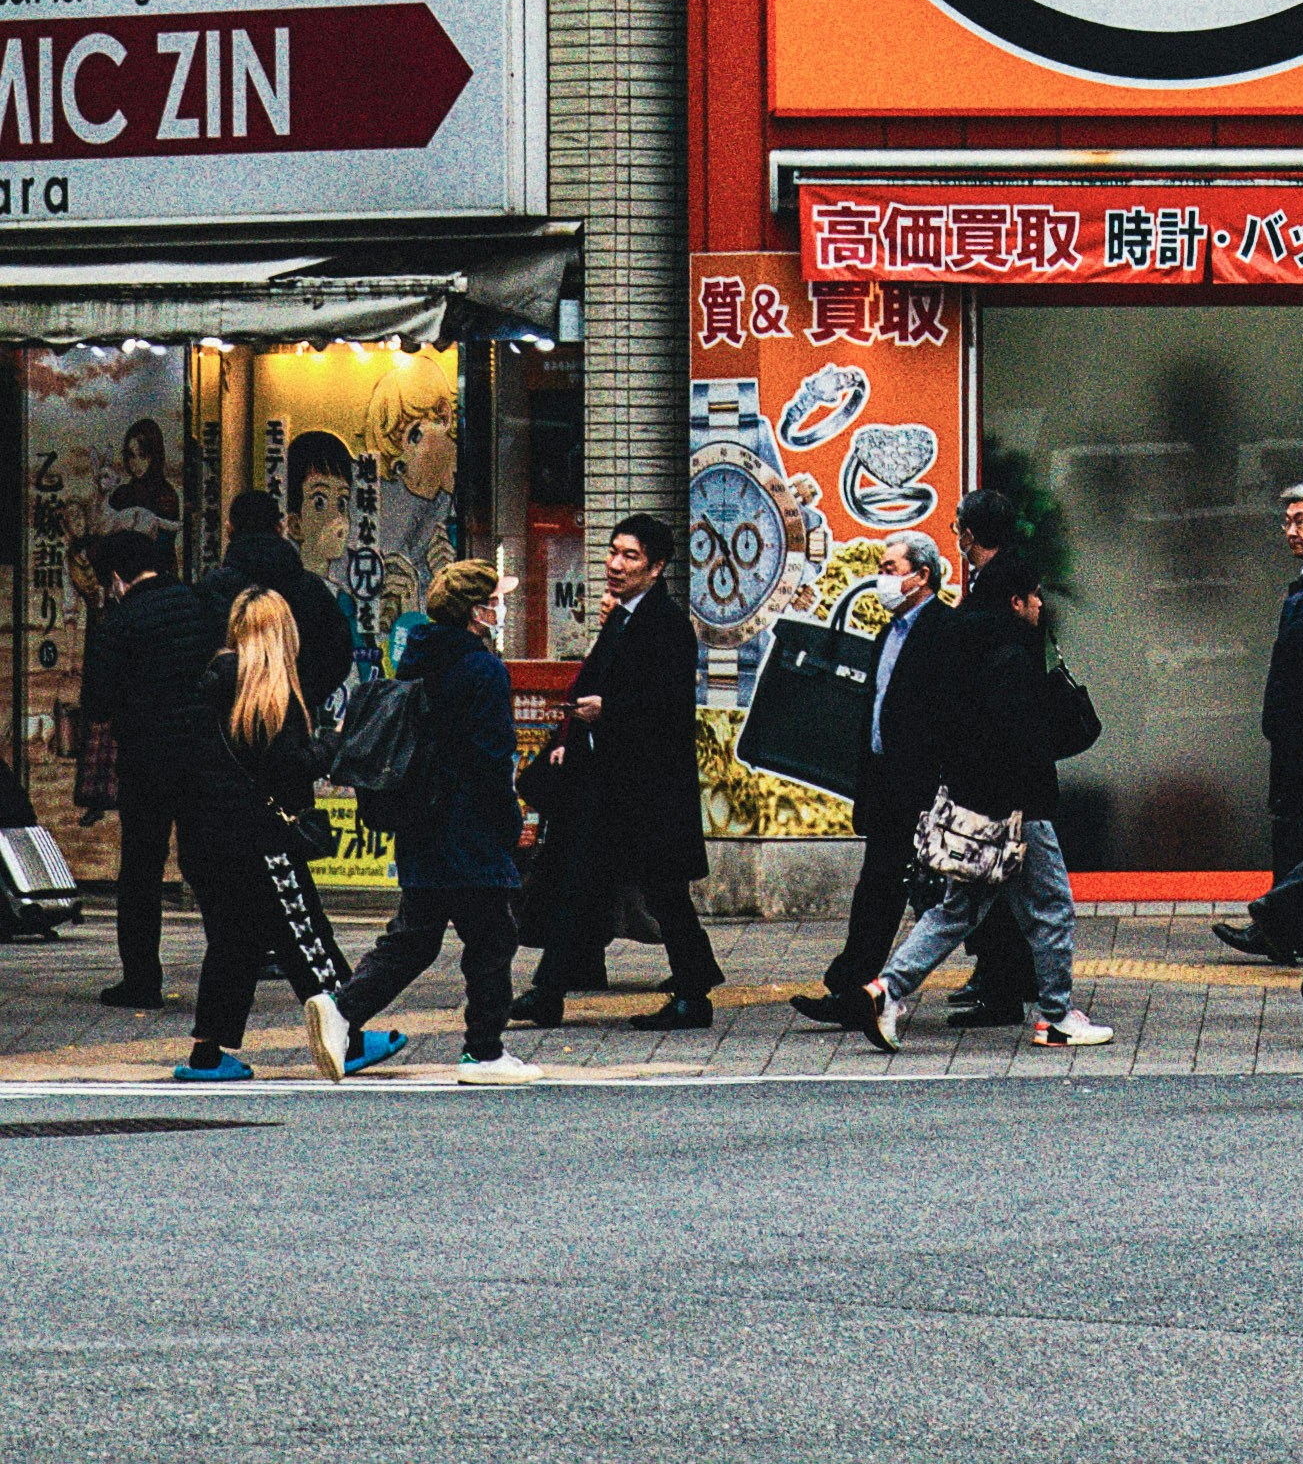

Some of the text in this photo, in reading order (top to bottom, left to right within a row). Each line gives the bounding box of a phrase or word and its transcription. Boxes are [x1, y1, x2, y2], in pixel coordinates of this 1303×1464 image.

[155, 26, 291, 141] ZIN
[812, 202, 1082, 273] 高価買取
